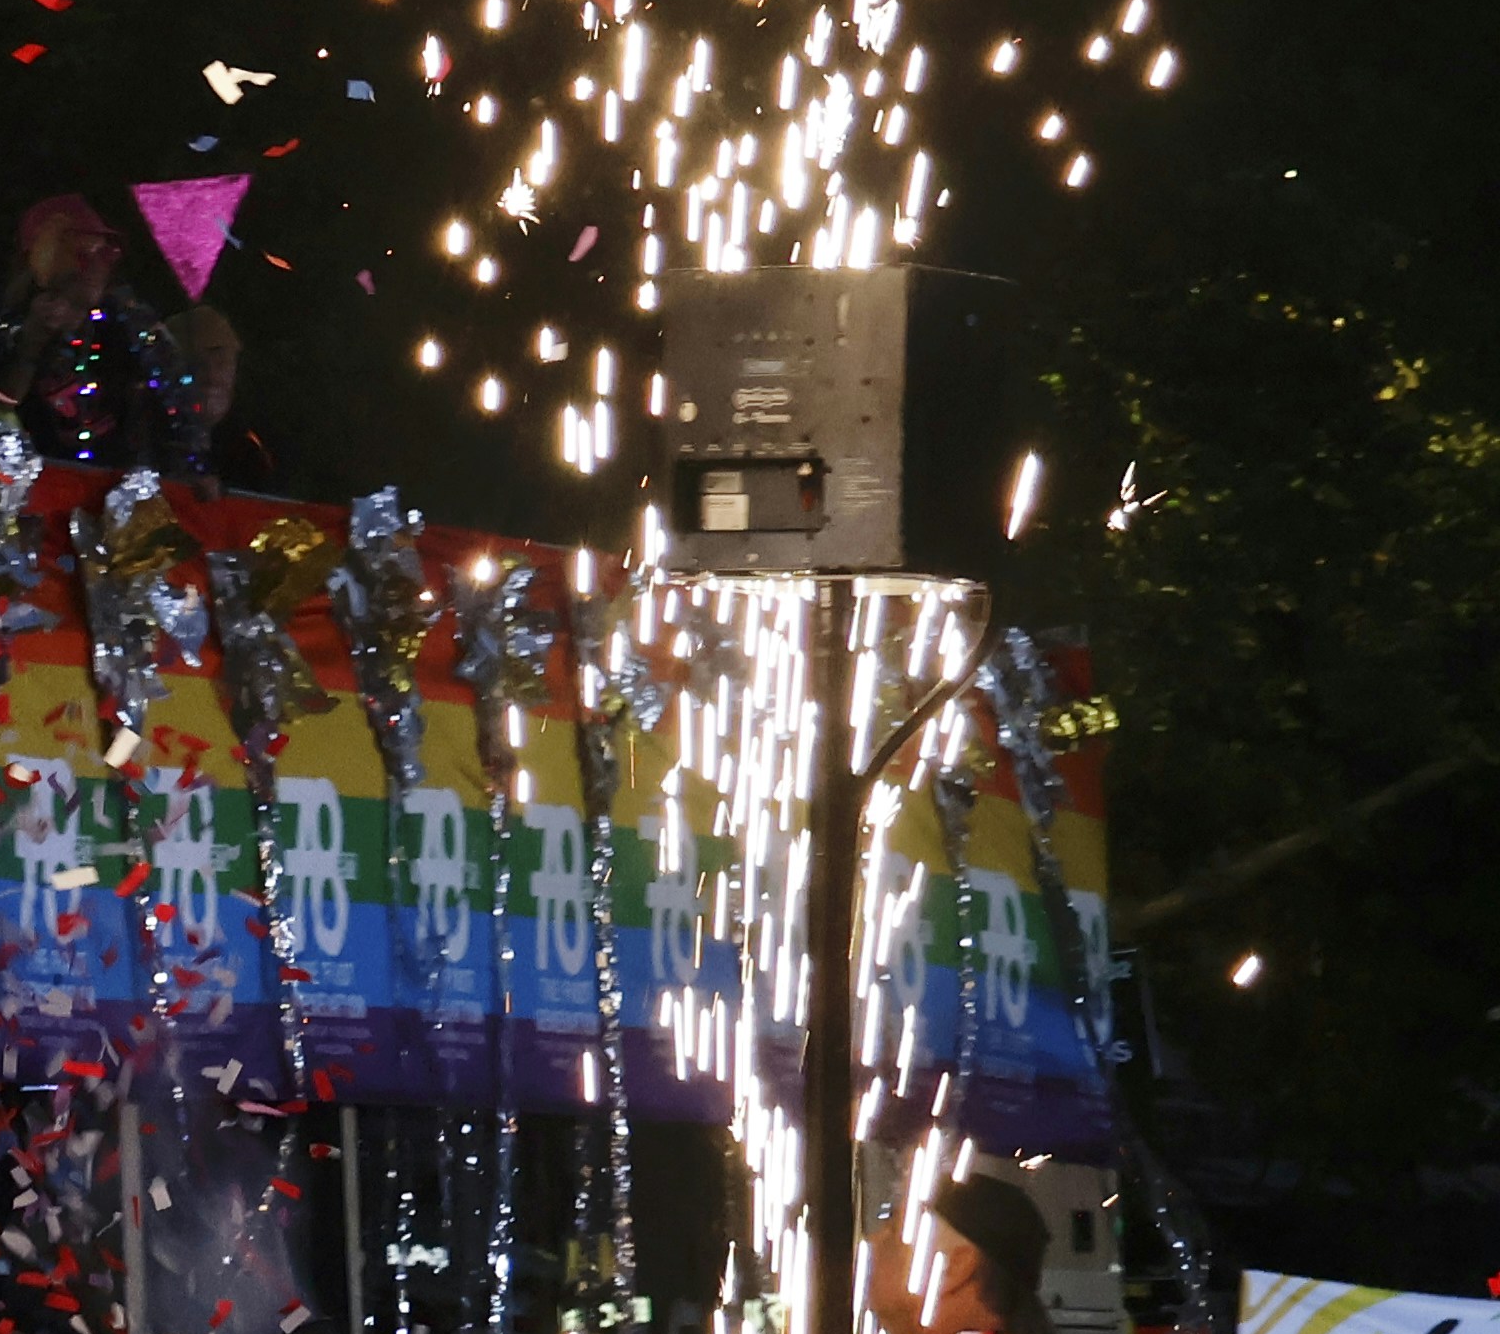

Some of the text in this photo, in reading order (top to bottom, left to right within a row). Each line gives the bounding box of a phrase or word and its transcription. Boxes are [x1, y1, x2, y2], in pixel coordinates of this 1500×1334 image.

[276, 777, 350, 957] 78
[404, 787, 471, 963] 78
[523, 804, 593, 976] 78
